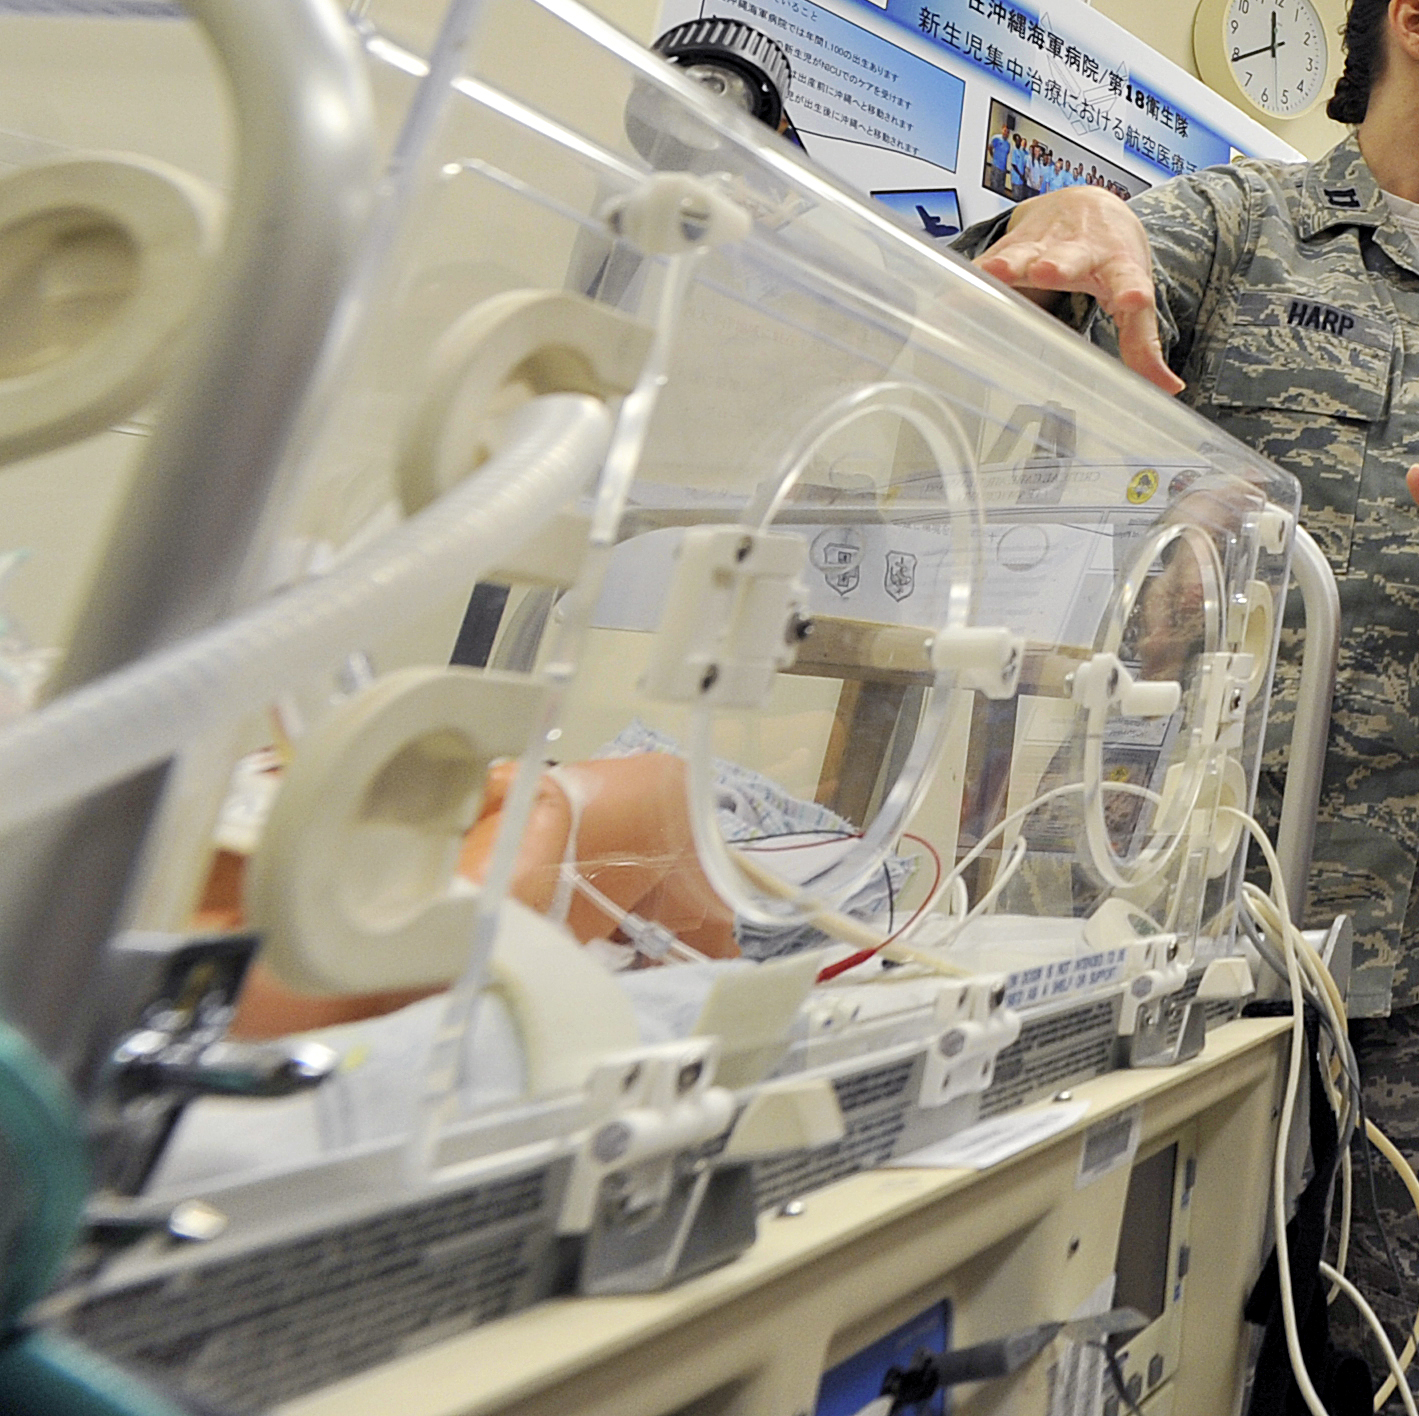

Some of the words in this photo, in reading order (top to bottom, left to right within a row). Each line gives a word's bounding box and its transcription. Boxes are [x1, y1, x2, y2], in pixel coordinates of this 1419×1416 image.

[1231, 20, 1239, 34] 9
[1303, 31, 1311, 46] 2
[1232, 47, 1240, 60] 8
[1305, 57, 1313, 72] 3
[1245, 71, 1253, 87] 7
[1296, 79, 1304, 93] 4
[1261, 88, 1269, 103] 6
[1280, 89, 1289, 105] 5
[1287, 302, 1355, 335] HARP
